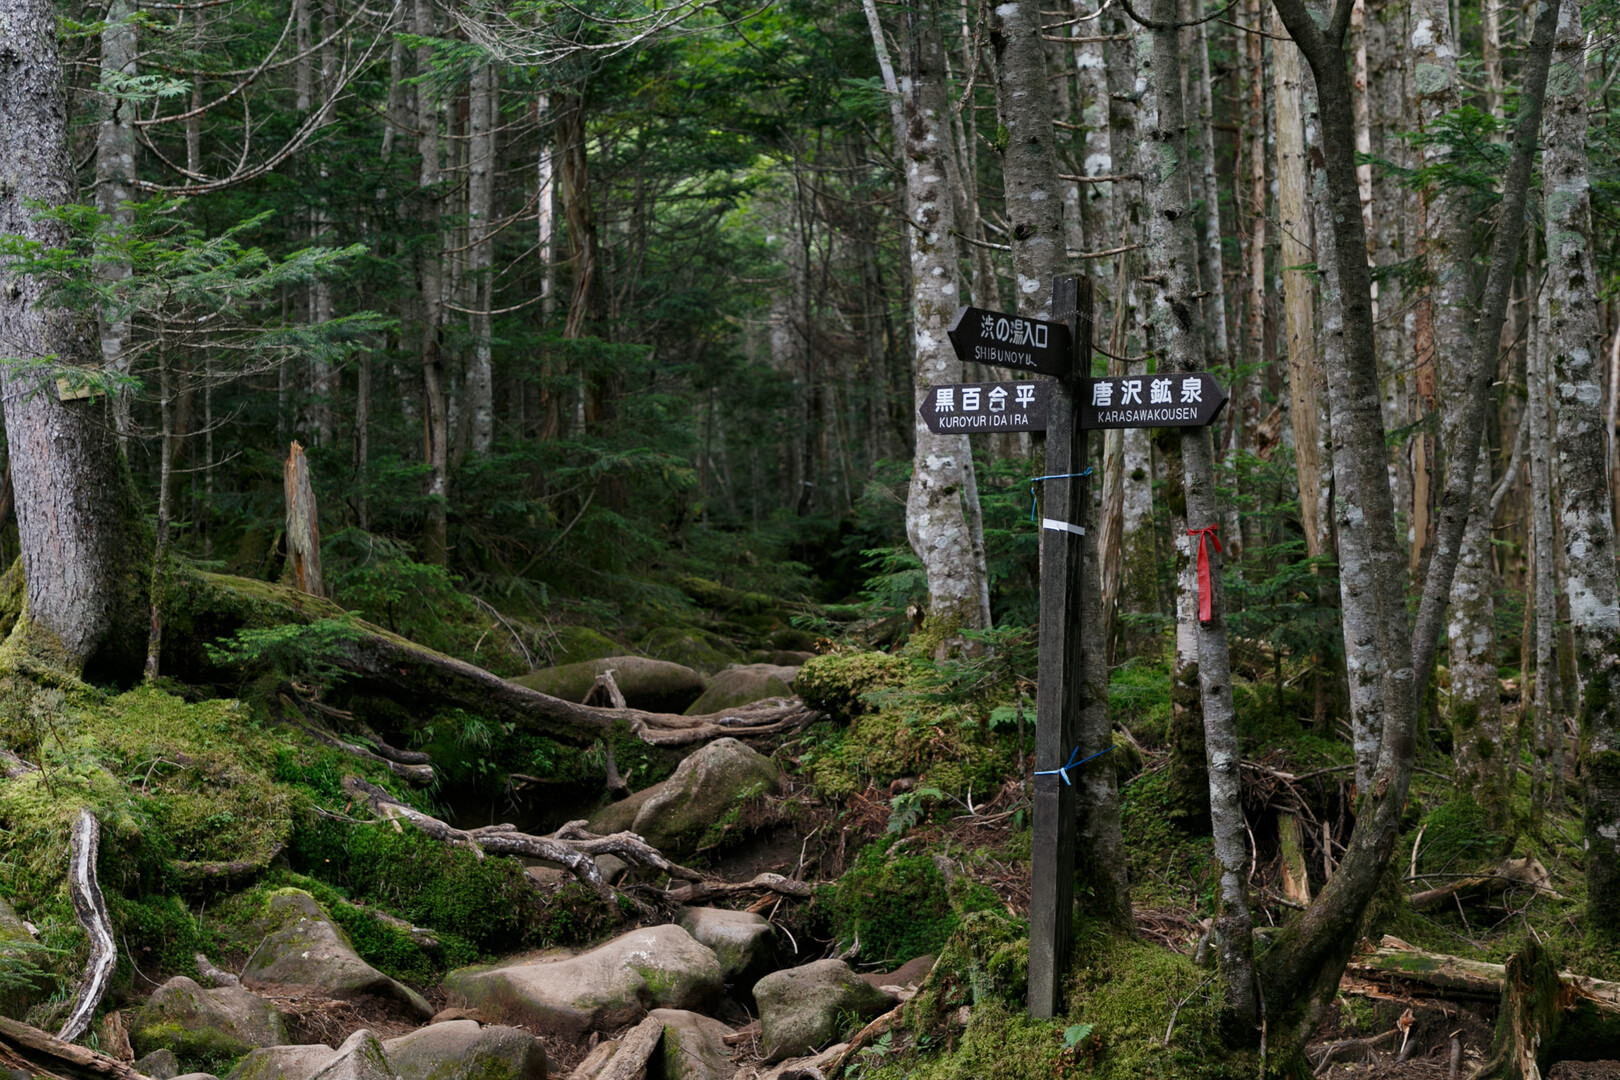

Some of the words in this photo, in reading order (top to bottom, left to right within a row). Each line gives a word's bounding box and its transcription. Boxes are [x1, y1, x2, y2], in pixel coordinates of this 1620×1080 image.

[981, 315, 1048, 348] 渋の湯入口
[974, 345, 1037, 367] SHIBUNOYU
[935, 384, 1036, 412] 黒百合平
[1092, 377, 1203, 407] 唐沢鉱泉
[1097, 407, 1198, 423] KARASAWAKOUSEN
